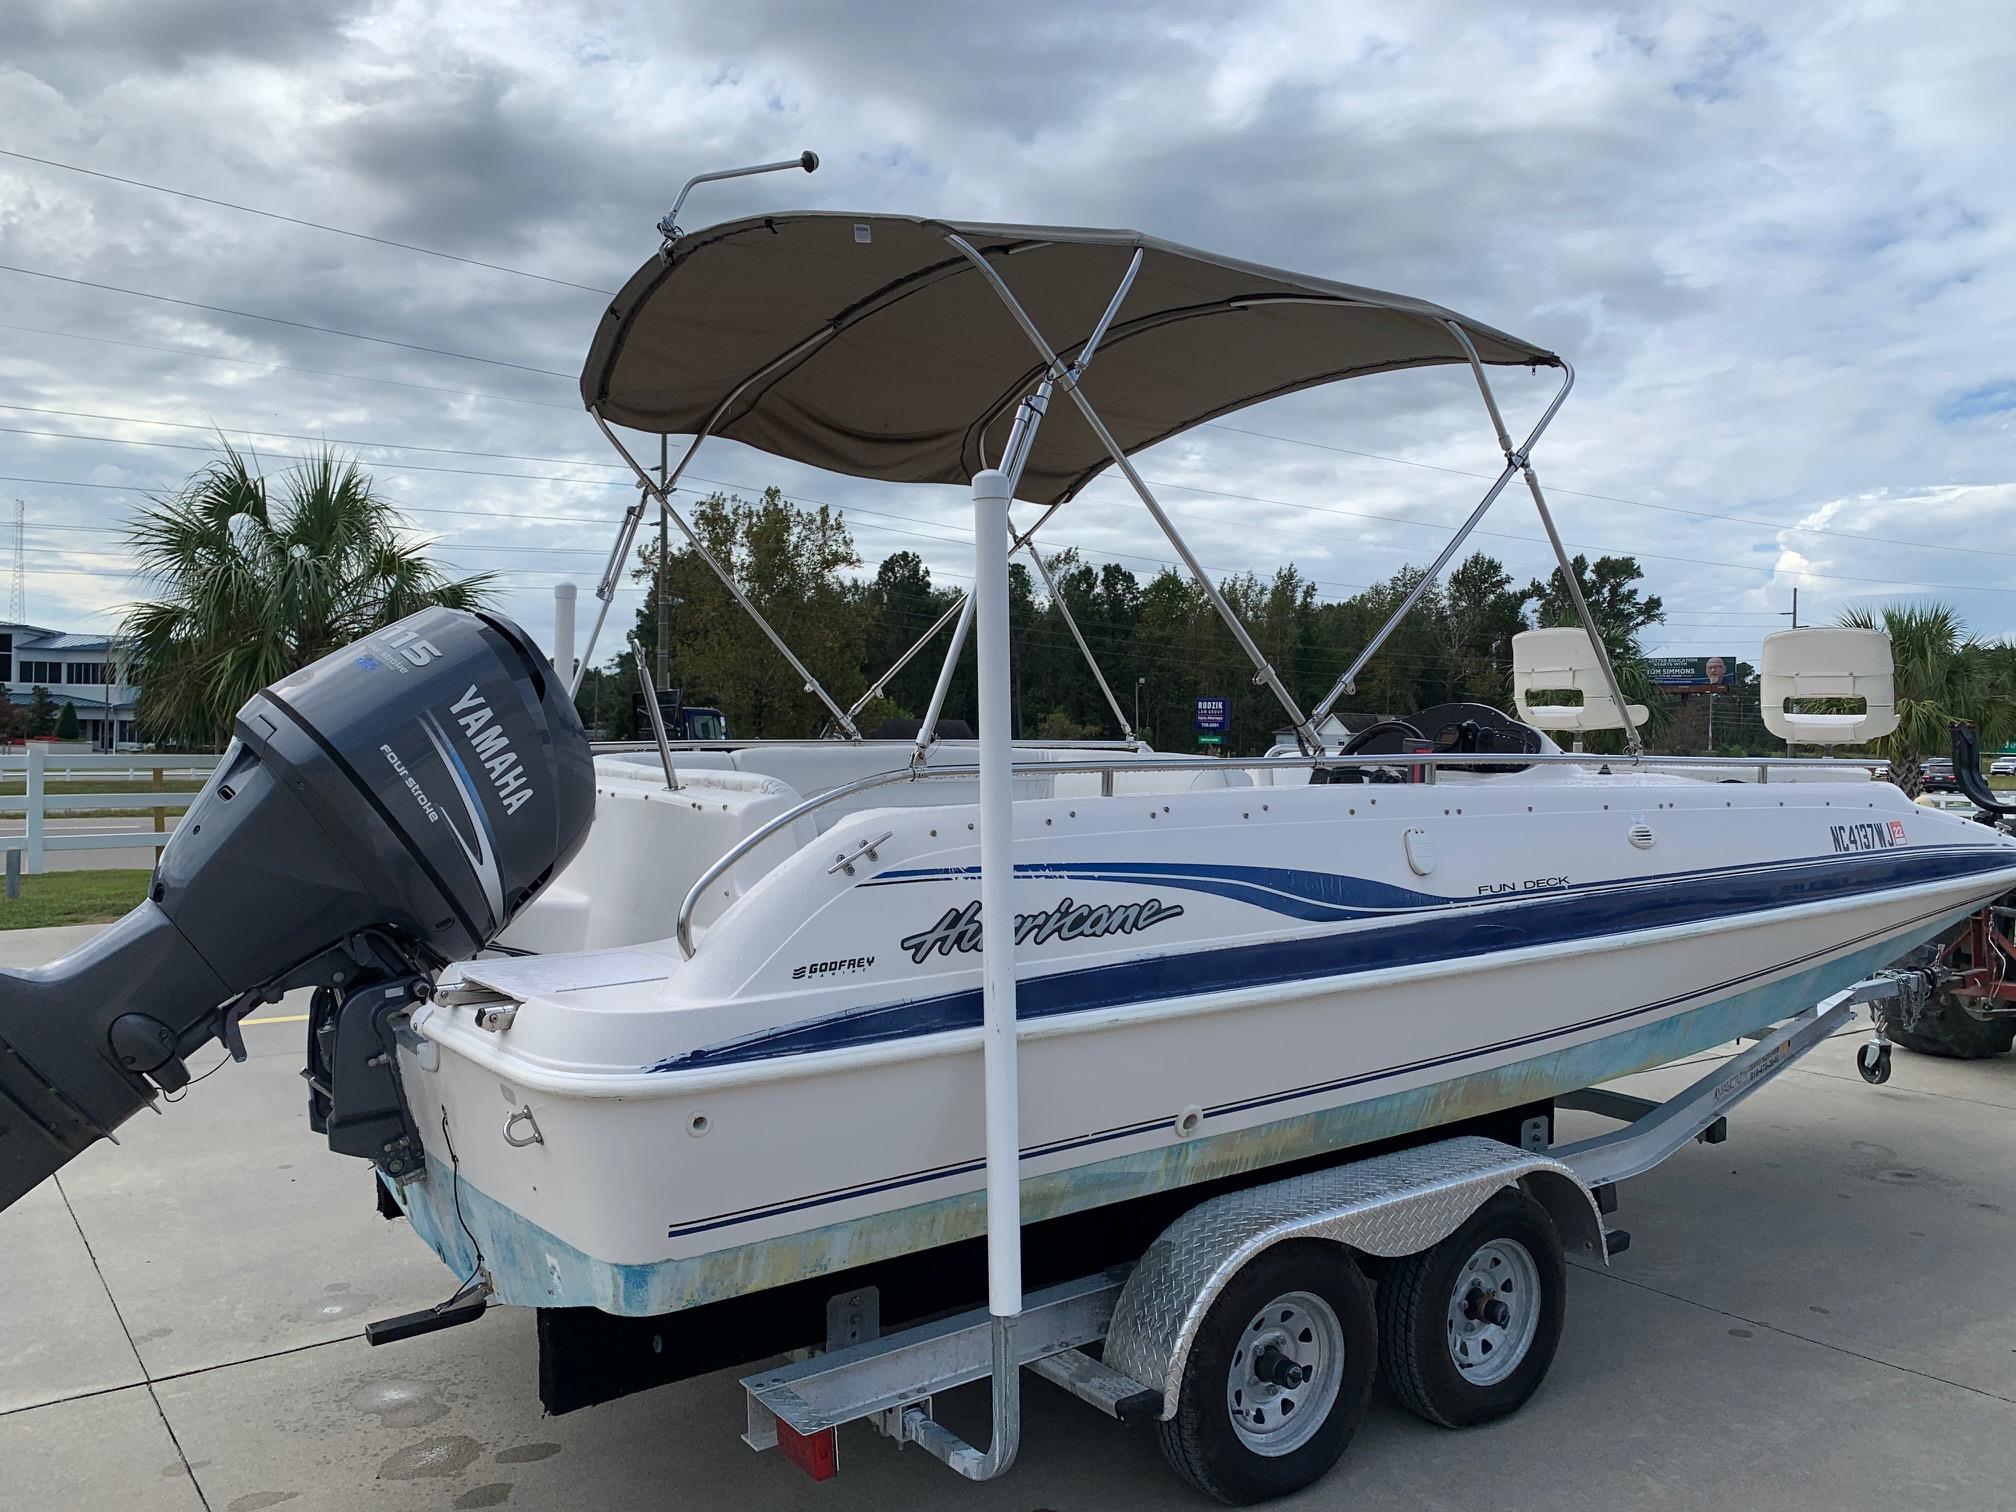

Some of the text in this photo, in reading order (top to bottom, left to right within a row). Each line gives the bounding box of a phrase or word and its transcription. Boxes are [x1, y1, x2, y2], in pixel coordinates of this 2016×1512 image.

[378, 625, 443, 668] 115
[1198, 701, 1223, 709] RODZIK
[449, 684, 534, 816] YAMAHA
[1478, 876, 1570, 895] FUN DECK
[901, 897, 1184, 965] Huricane
[808, 956, 875, 974] GODFREY
